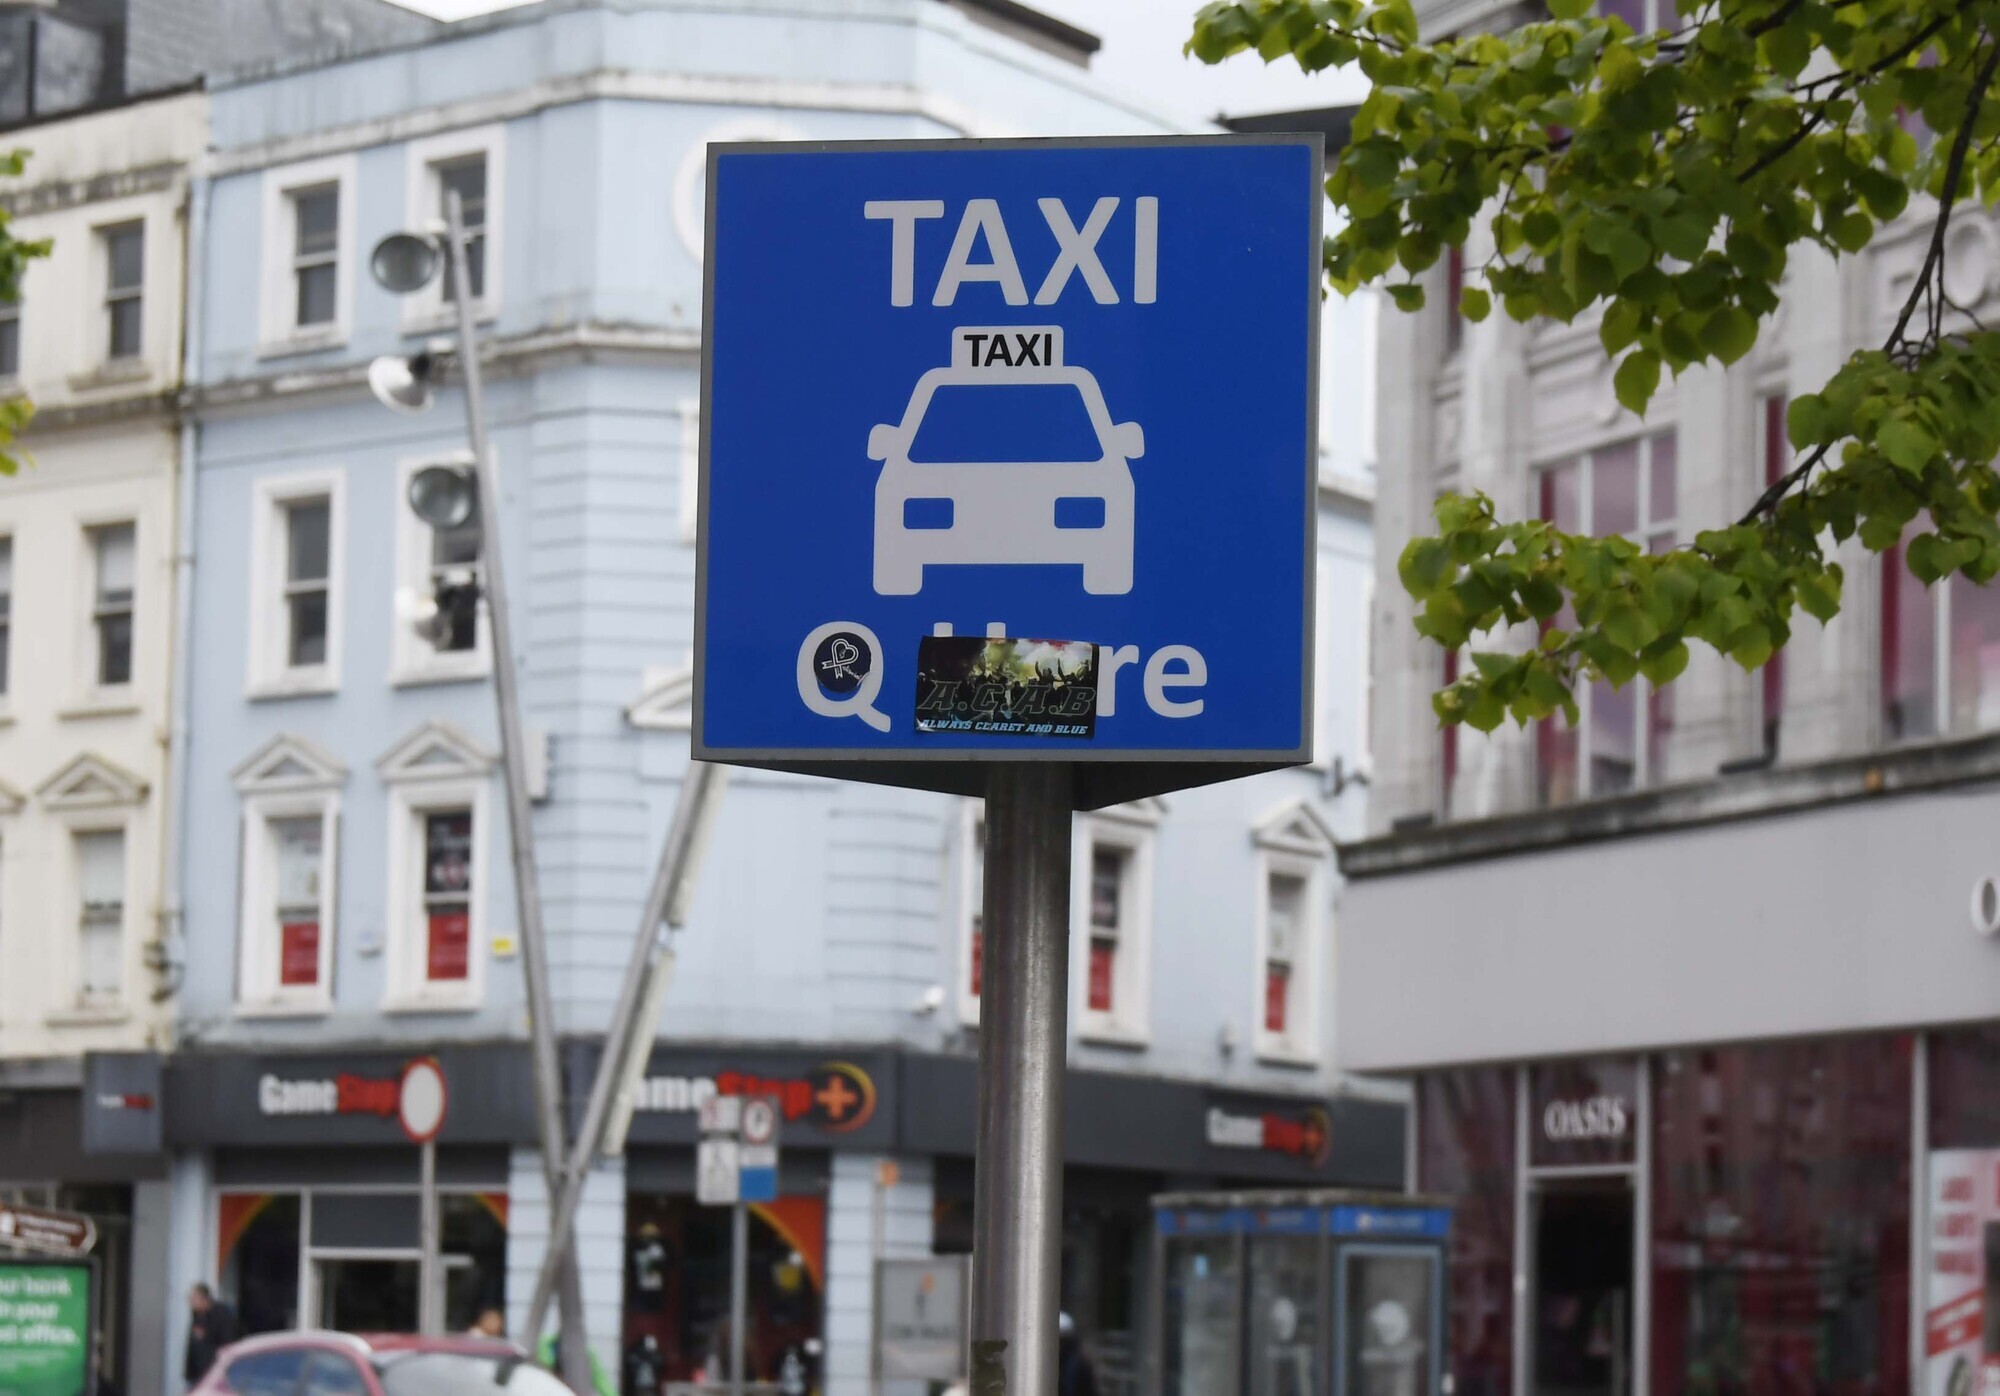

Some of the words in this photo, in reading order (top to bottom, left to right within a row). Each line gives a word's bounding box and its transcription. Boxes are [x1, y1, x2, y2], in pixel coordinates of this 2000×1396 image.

[864, 196, 1158, 307] TAXI
[963, 333, 1052, 367] TAXI
[797, 620, 891, 733] Q
[921, 719, 972, 730] ALWAYS
[975, 721, 1025, 732] CLARET
[1026, 724, 1053, 733] AND
[1054, 724, 1088, 735] BLUE
[1543, 1097, 1626, 1141] OASIS
